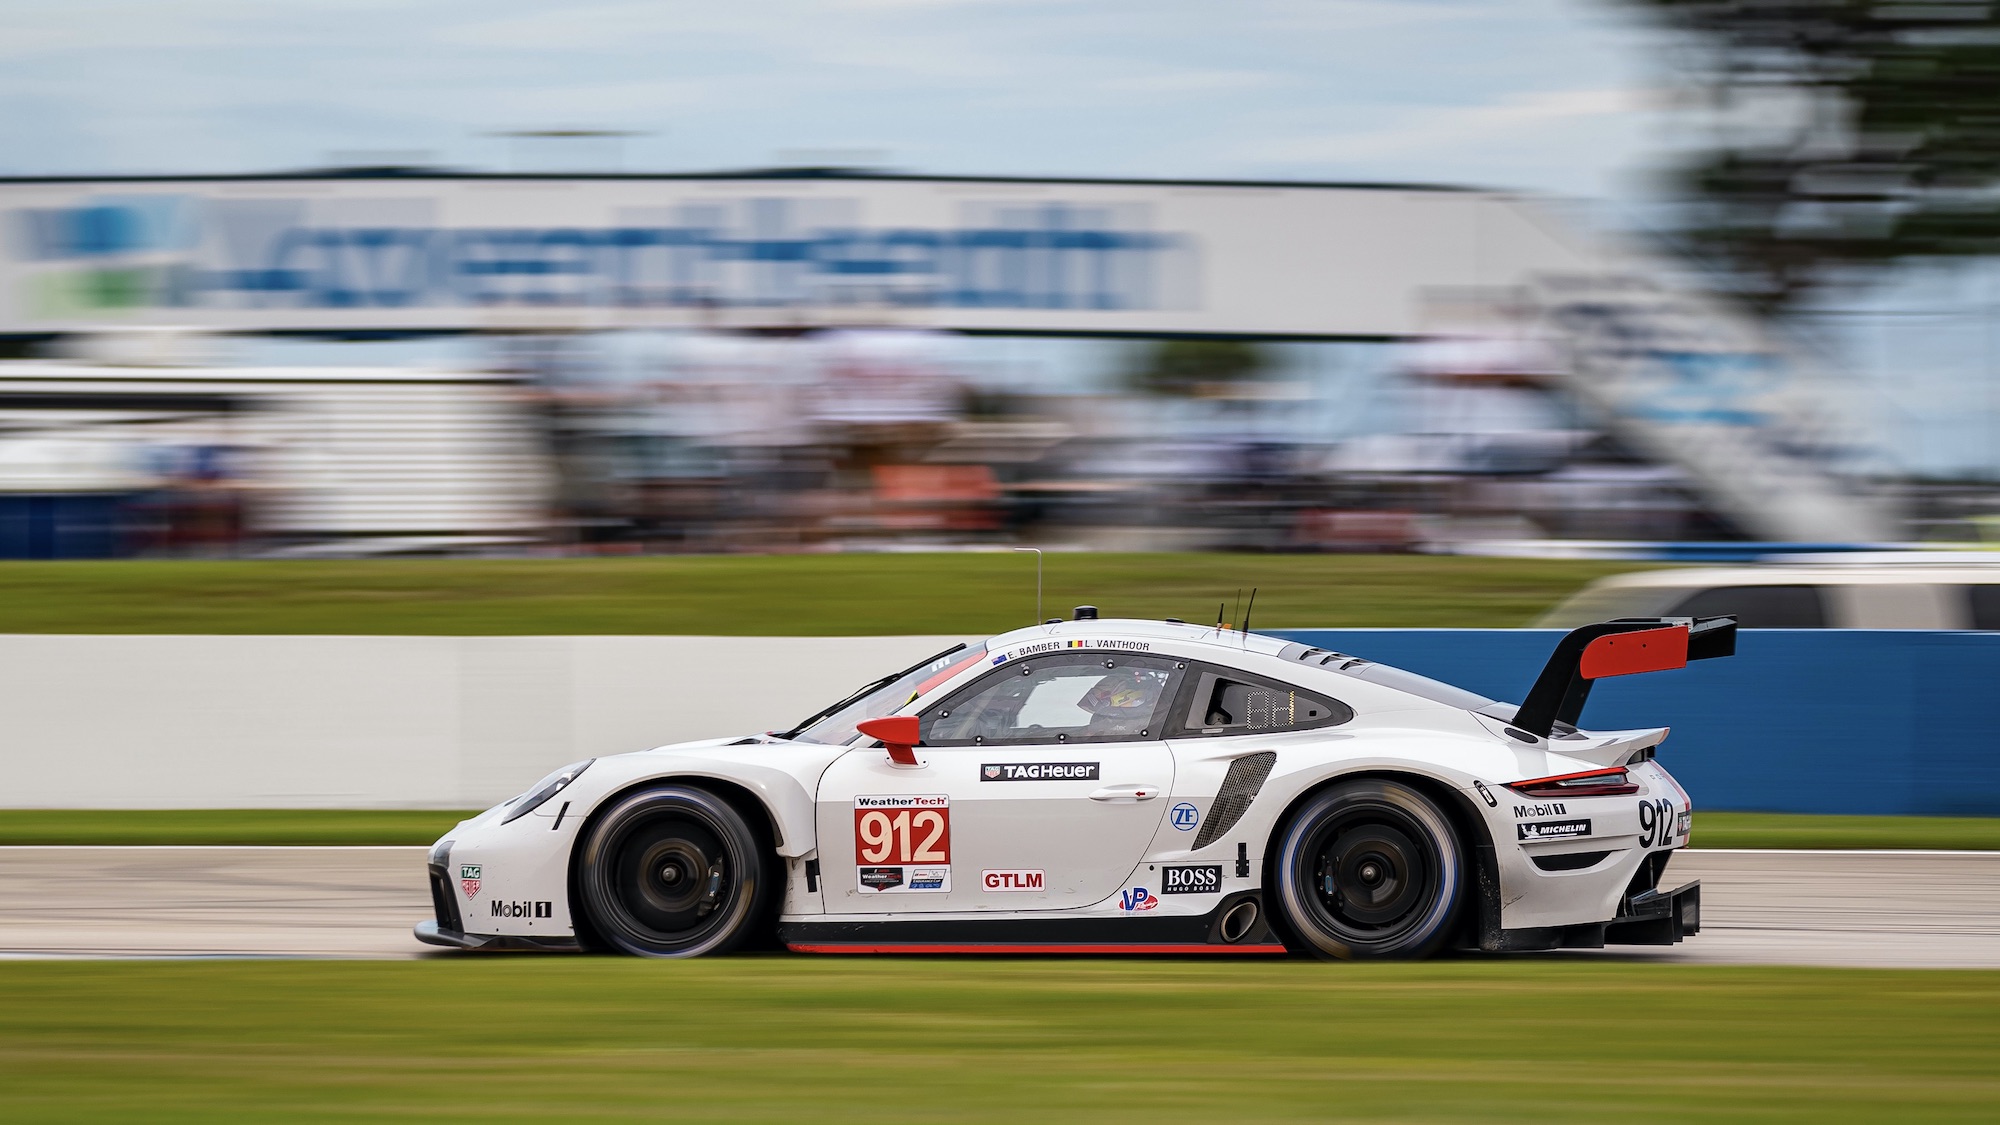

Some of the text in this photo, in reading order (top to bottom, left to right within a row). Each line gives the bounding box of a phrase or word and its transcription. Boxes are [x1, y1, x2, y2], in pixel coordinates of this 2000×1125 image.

[1008, 641, 1060, 660] E. BAMBER
[1085, 639, 1150, 651] L. VANTHOOR
[1174, 808, 1197, 825] ZF
[1513, 803, 1552, 818] Mobil
[1540, 824, 1587, 834] MICHELIN
[1638, 798, 1674, 849] 912
[859, 810, 946, 863] 912
[462, 867, 480, 878] TAG
[985, 873, 1042, 888] GTLM
[1167, 868, 1217, 886] BOSS
[1122, 887, 1148, 911] VP
[491, 900, 531, 918] Mobil
